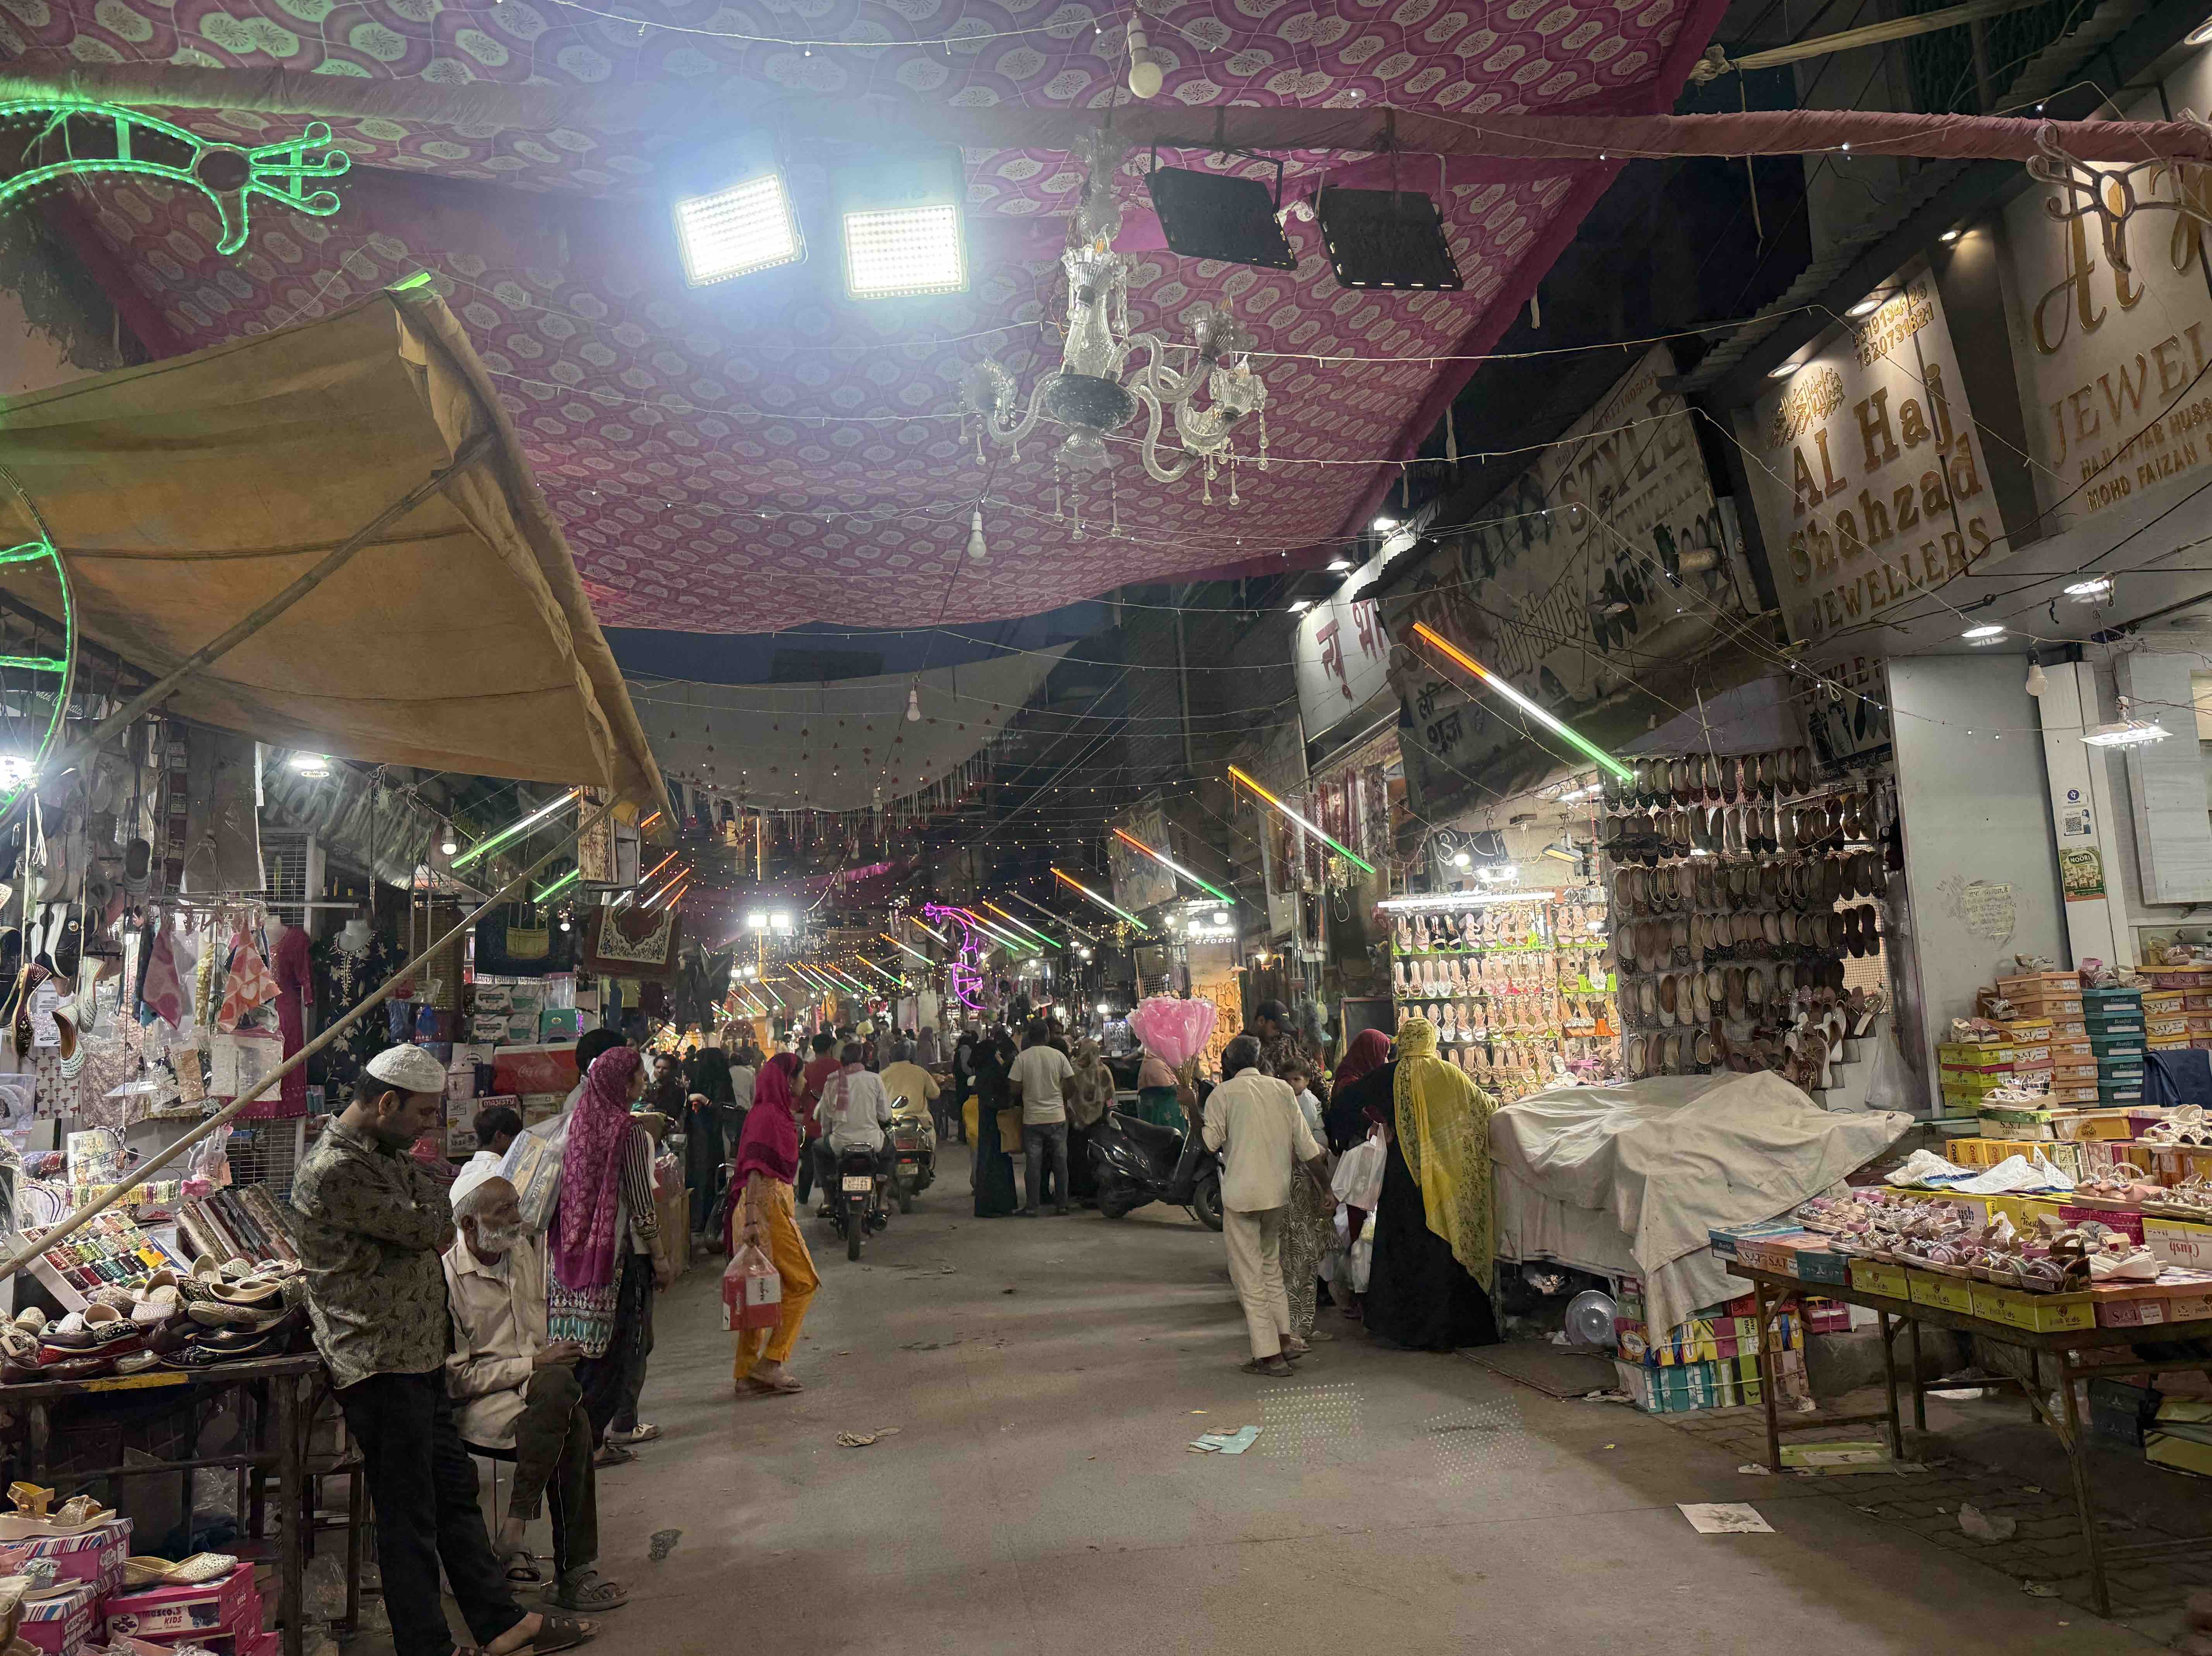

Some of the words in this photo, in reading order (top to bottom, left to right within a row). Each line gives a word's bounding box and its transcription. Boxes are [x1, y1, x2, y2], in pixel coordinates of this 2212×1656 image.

[1560, 392, 1685, 534] STYLE
[1793, 428, 1847, 516] AL
[1853, 363, 1953, 475] Haj
[2086, 474, 2131, 511] MOHD
[2136, 441, 2198, 489] FAIZAN
[1788, 432, 1982, 585] Shahzad
[1811, 517, 1991, 632] JEWELLERS
[1958, 1206, 1974, 1221] ush
[2169, 1241, 2200, 1258] Crush
[164, 1616, 182, 1624] KIDS
